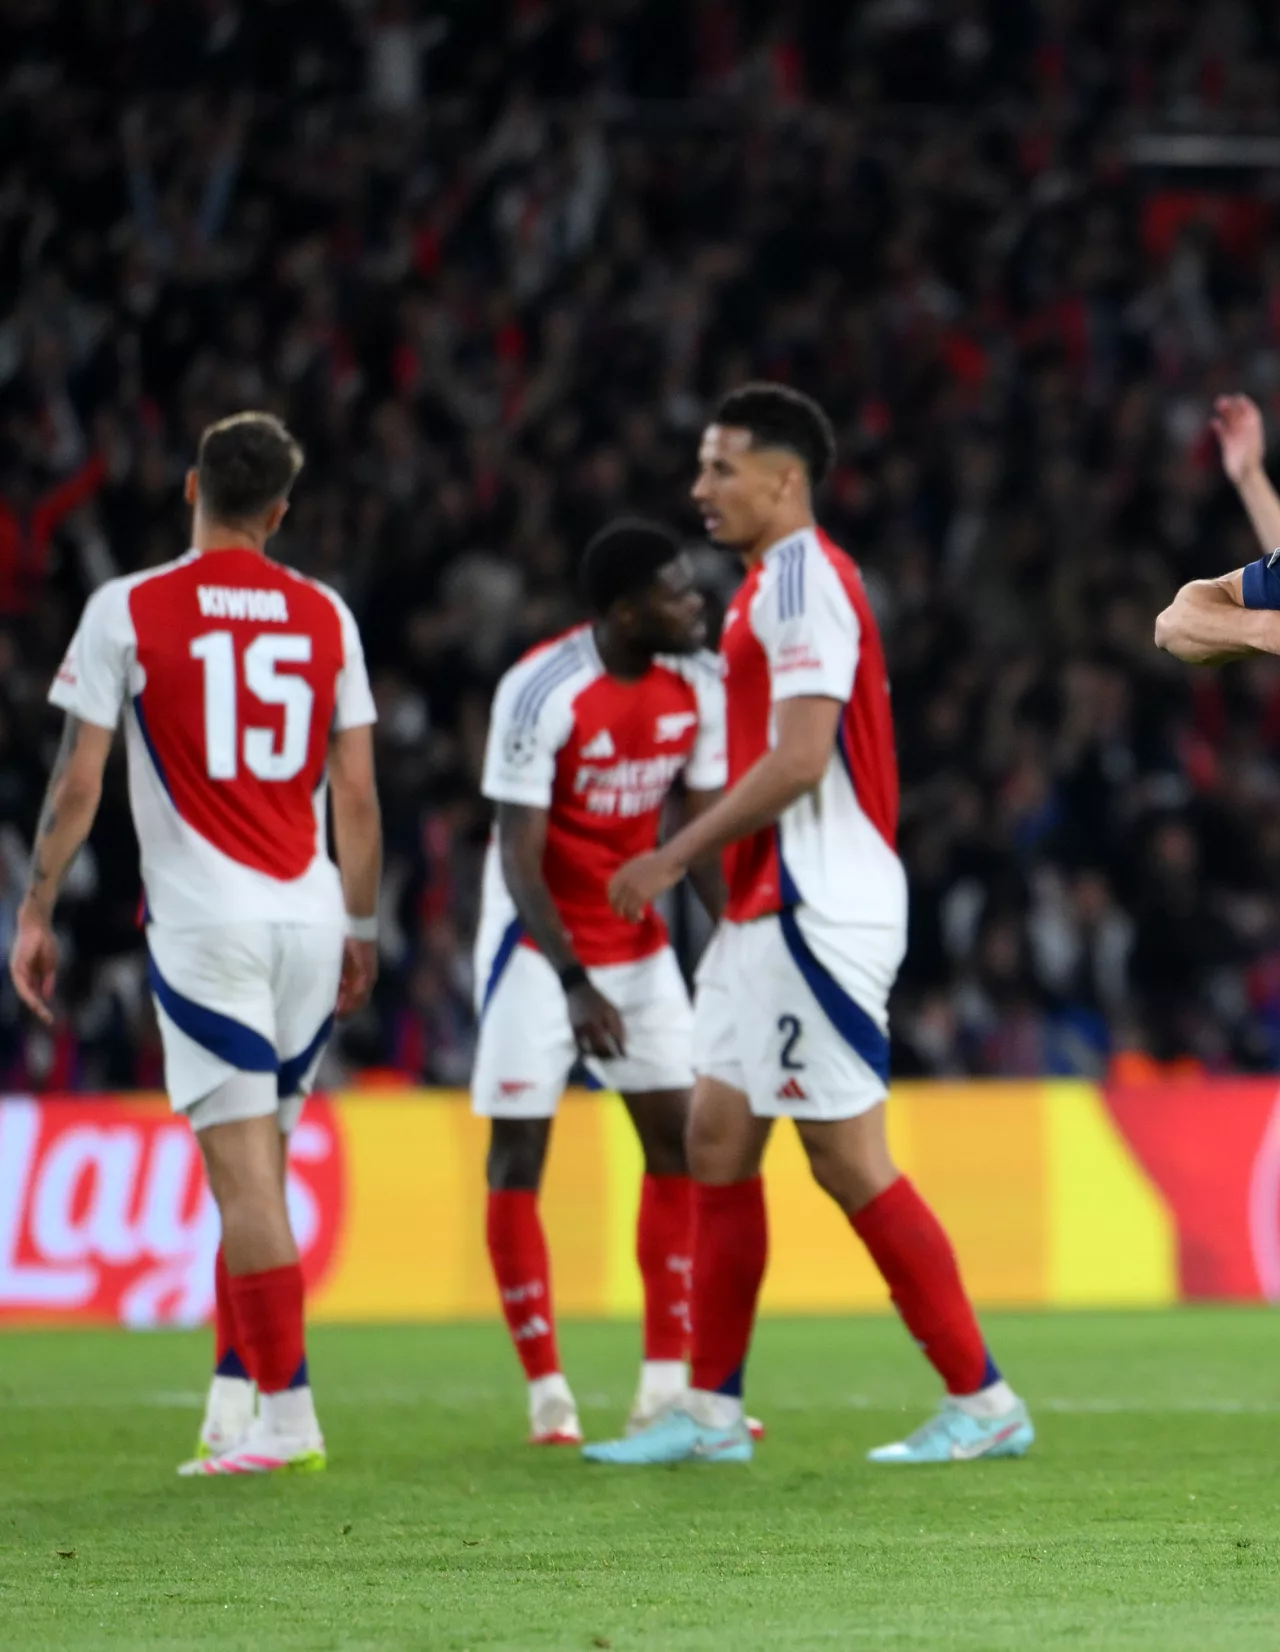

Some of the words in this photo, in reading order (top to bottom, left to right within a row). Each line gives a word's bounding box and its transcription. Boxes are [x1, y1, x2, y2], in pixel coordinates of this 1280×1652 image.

[196, 584, 289, 623] KIWIOR
[189, 629, 315, 781] 15
[777, 1012, 805, 1070] 2
[0, 1096, 334, 1331] Lays
